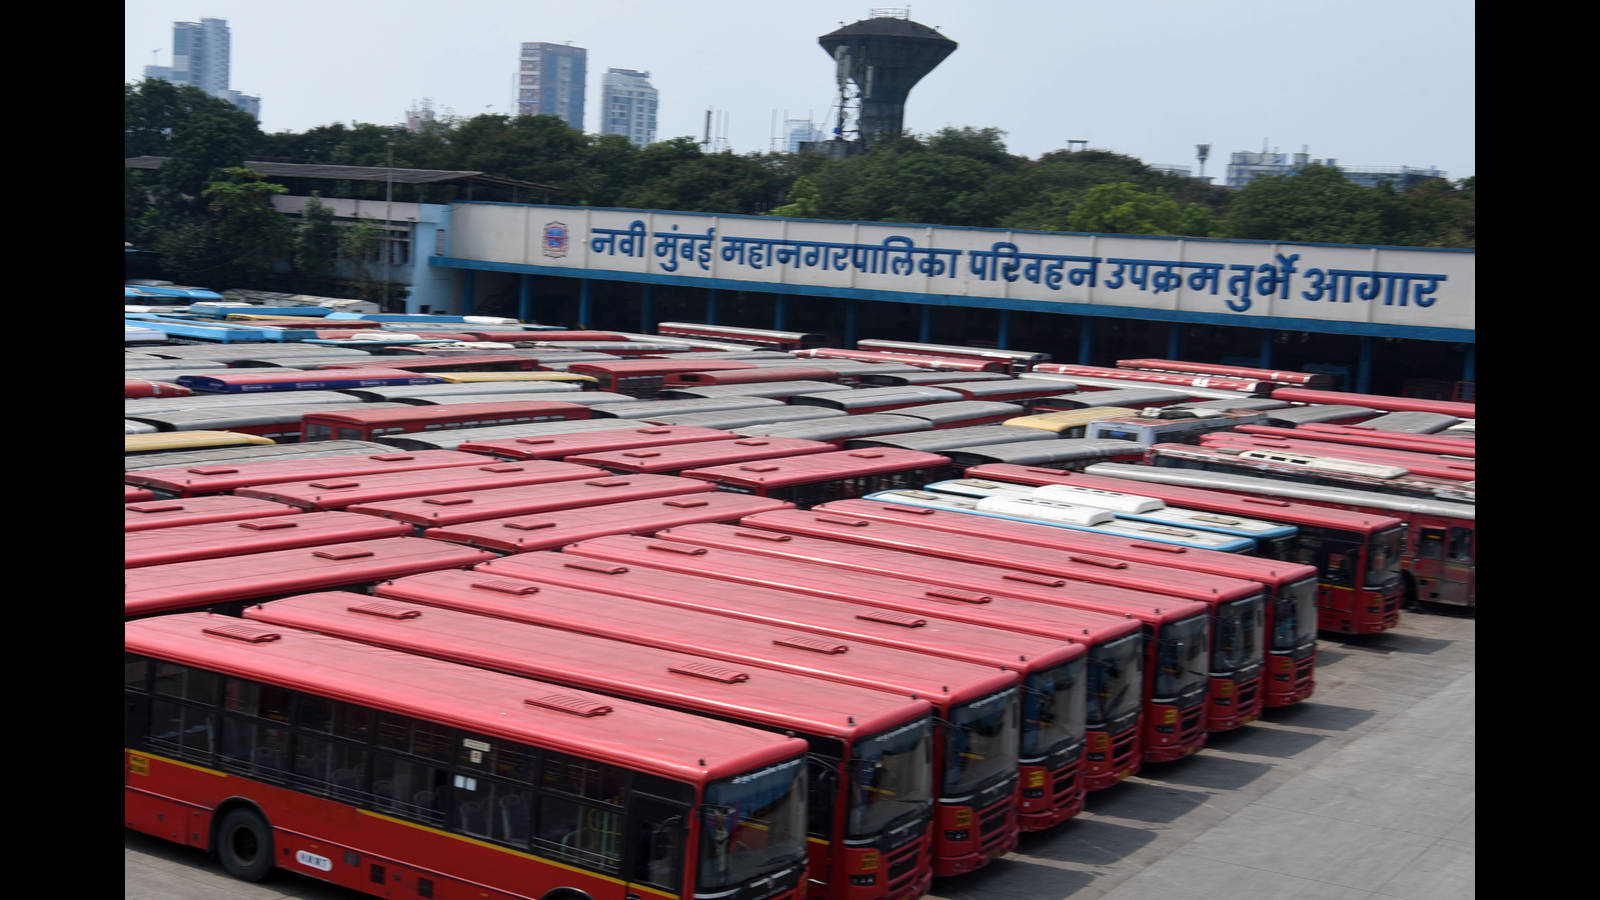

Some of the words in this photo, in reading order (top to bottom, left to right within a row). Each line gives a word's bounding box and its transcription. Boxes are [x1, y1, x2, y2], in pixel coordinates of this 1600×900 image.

[590, 220, 647, 258] नवी
[653, 224, 716, 272] मुंबई
[720, 235, 964, 279] महानगरपालिका
[968, 241, 1103, 290] परिवहन
[1103, 257, 1226, 296] उपक्रम
[1225, 252, 1301, 312] तुर्भे
[1302, 267, 1448, 308] आगार
